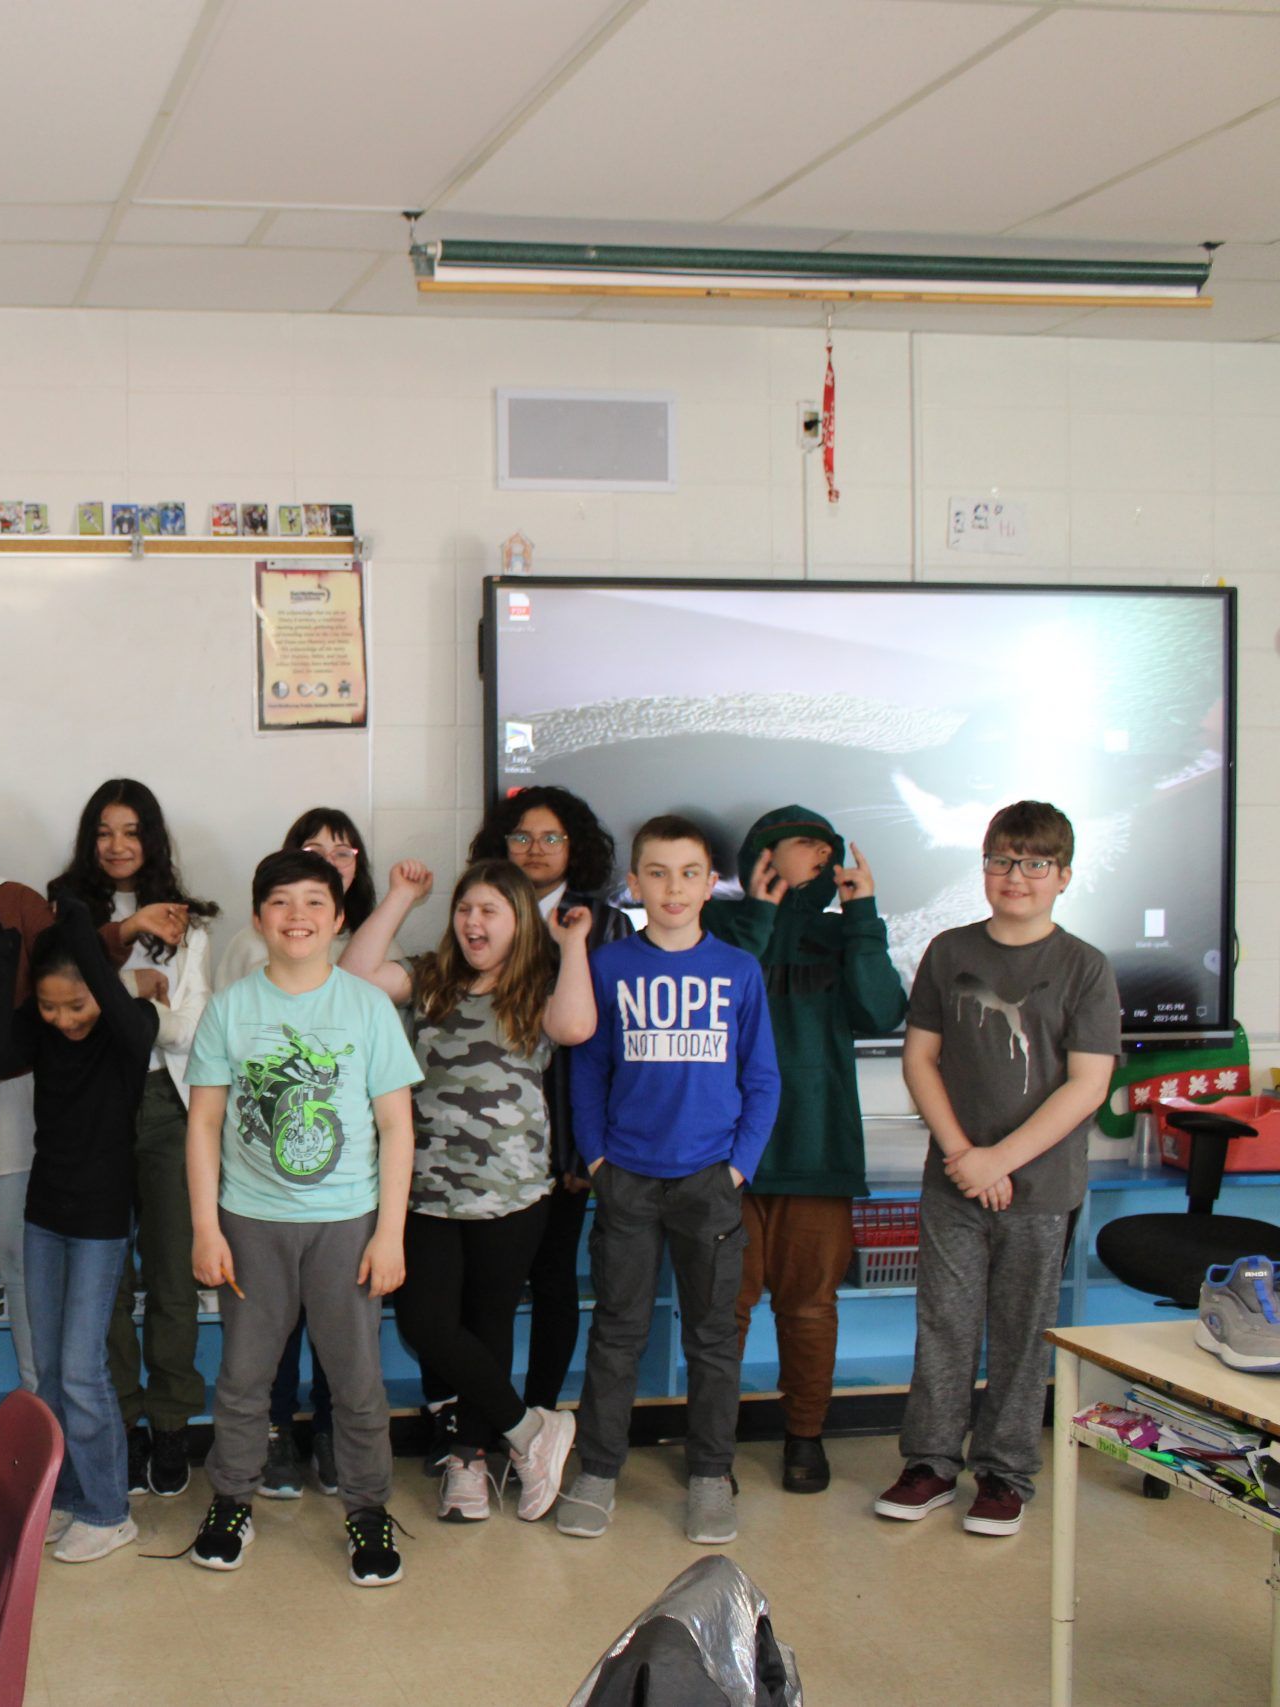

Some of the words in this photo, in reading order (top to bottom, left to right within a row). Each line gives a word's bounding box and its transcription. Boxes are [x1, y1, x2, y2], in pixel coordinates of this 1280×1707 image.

[617, 975, 732, 1030] NOPE
[628, 1033, 660, 1057] NOT
[666, 1033, 723, 1058] TODAY
